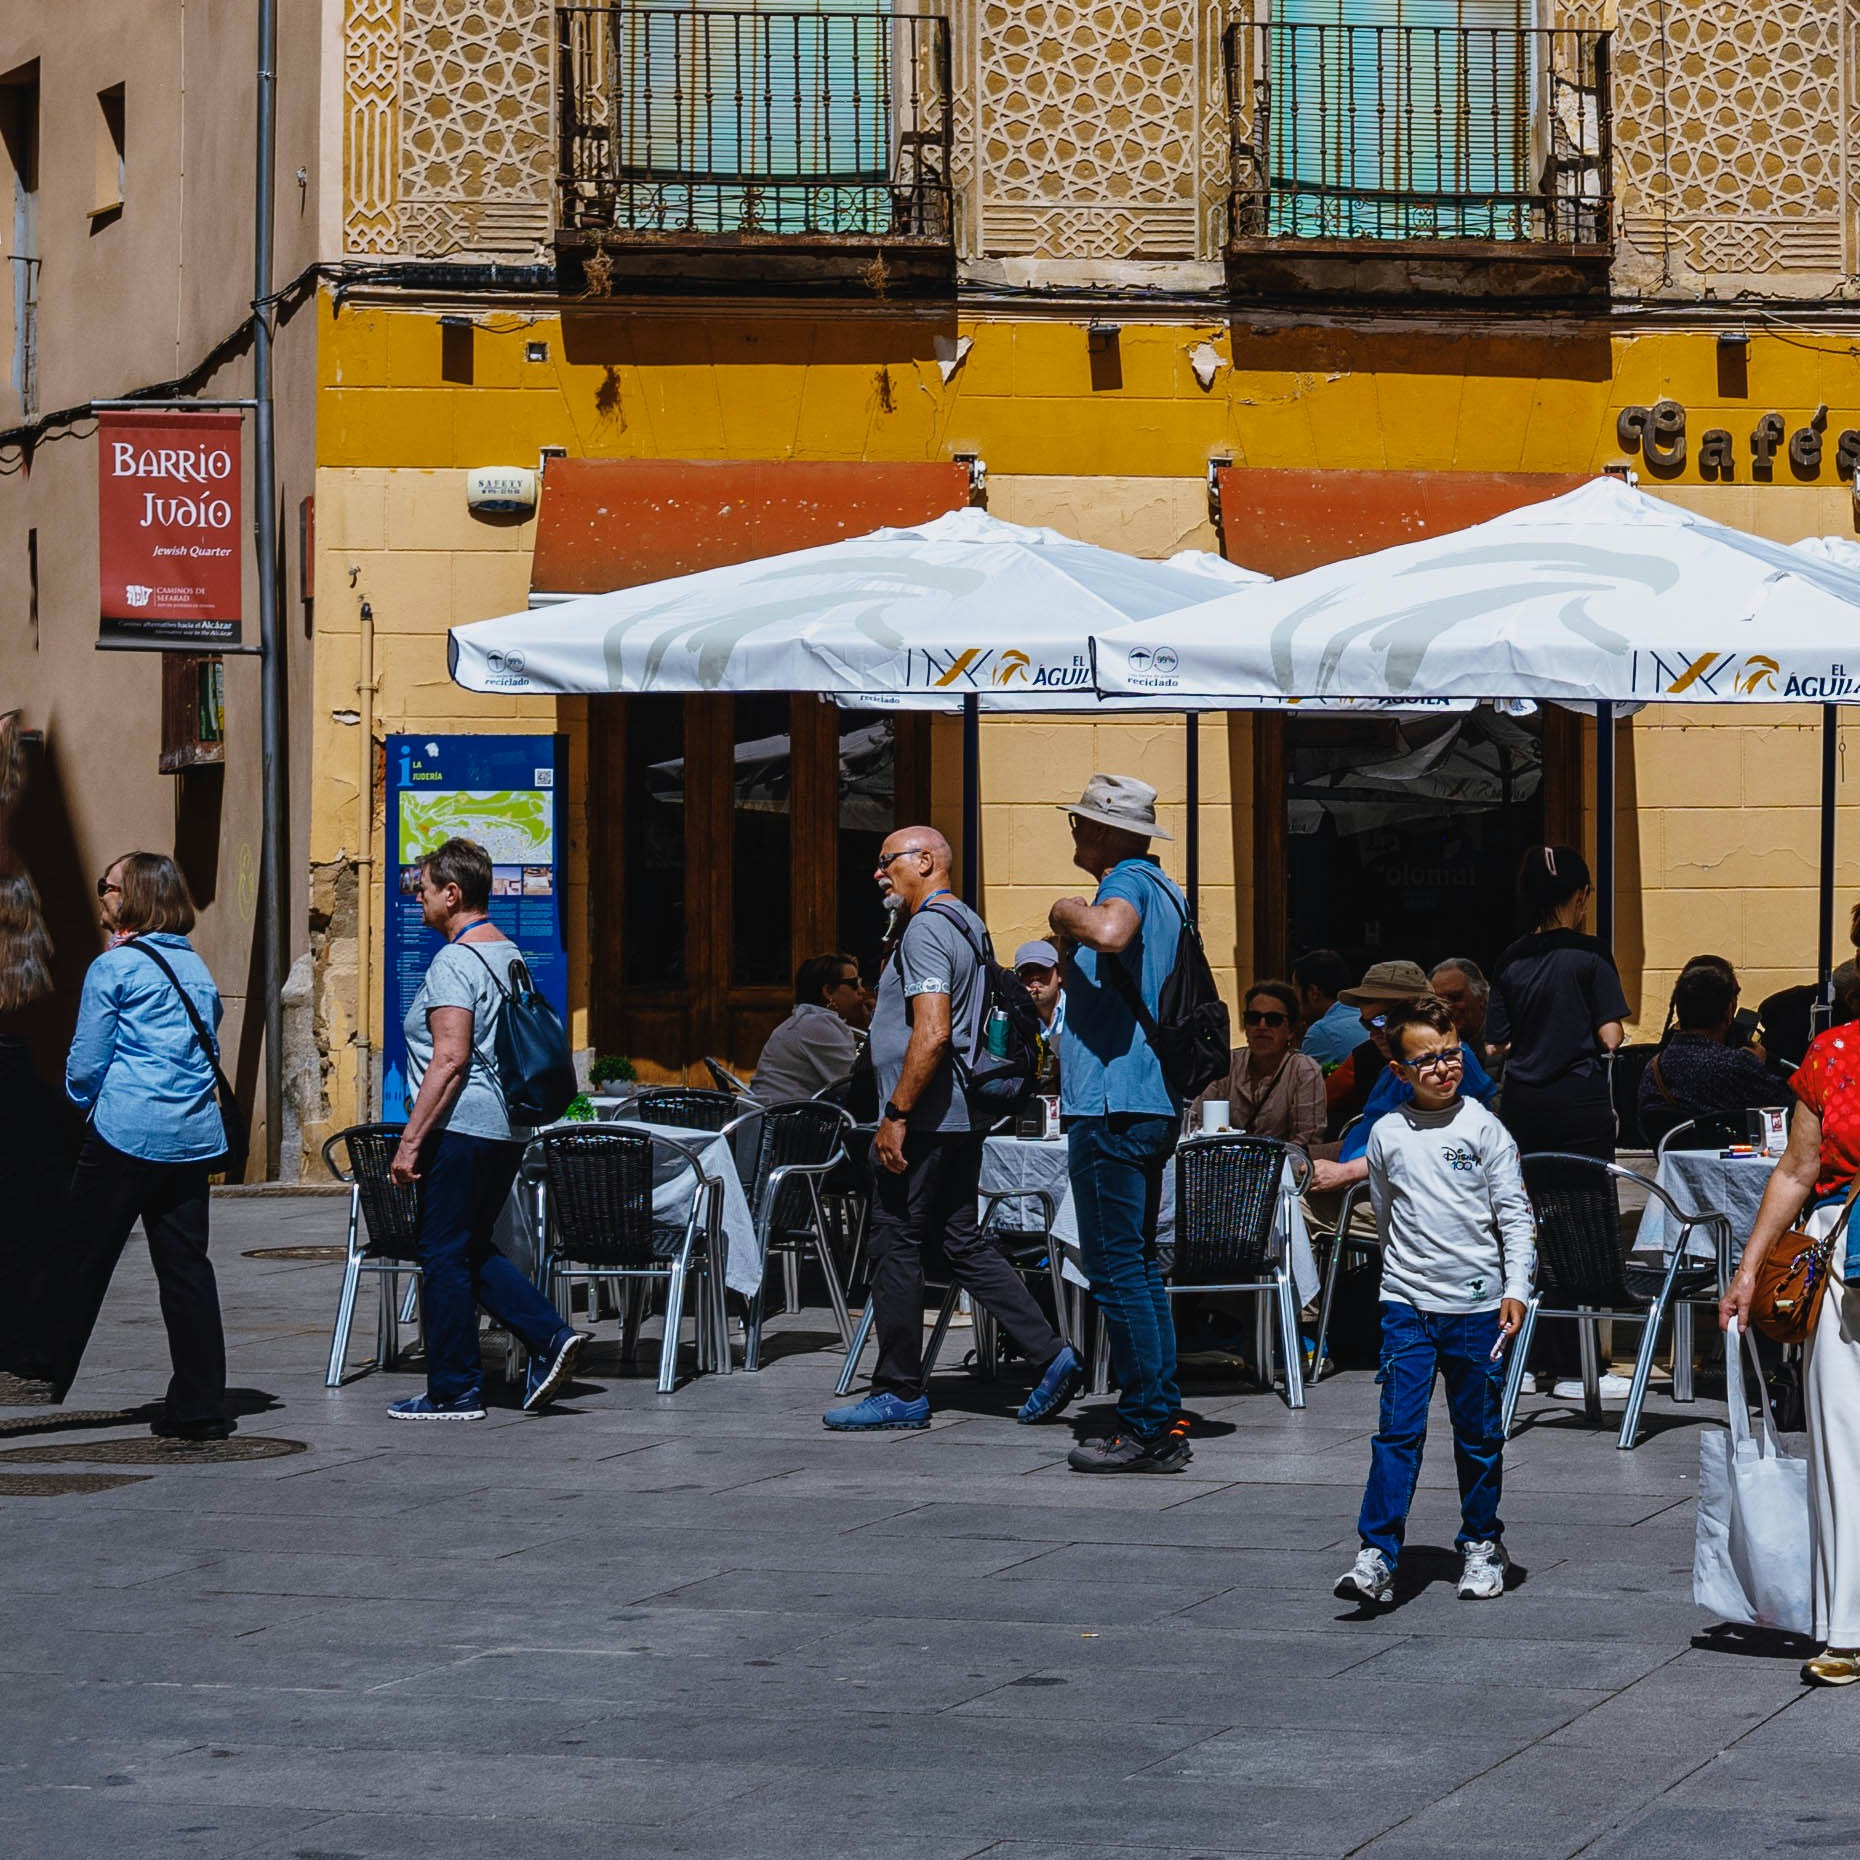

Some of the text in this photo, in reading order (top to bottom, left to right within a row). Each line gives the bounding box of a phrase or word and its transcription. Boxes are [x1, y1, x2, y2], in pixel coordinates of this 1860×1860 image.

[153, 545, 231, 558] Jewish Quarter
[1072, 655, 1085, 667] EL
[1032, 664, 1090, 687] ÁGUIL
[1831, 663, 1847, 677] EL
[1127, 678, 1179, 687] reciclado
[412, 761, 422, 769] LA
[412, 771, 443, 781] JUDERÍA
[1451, 1160, 1473, 1172] 100
